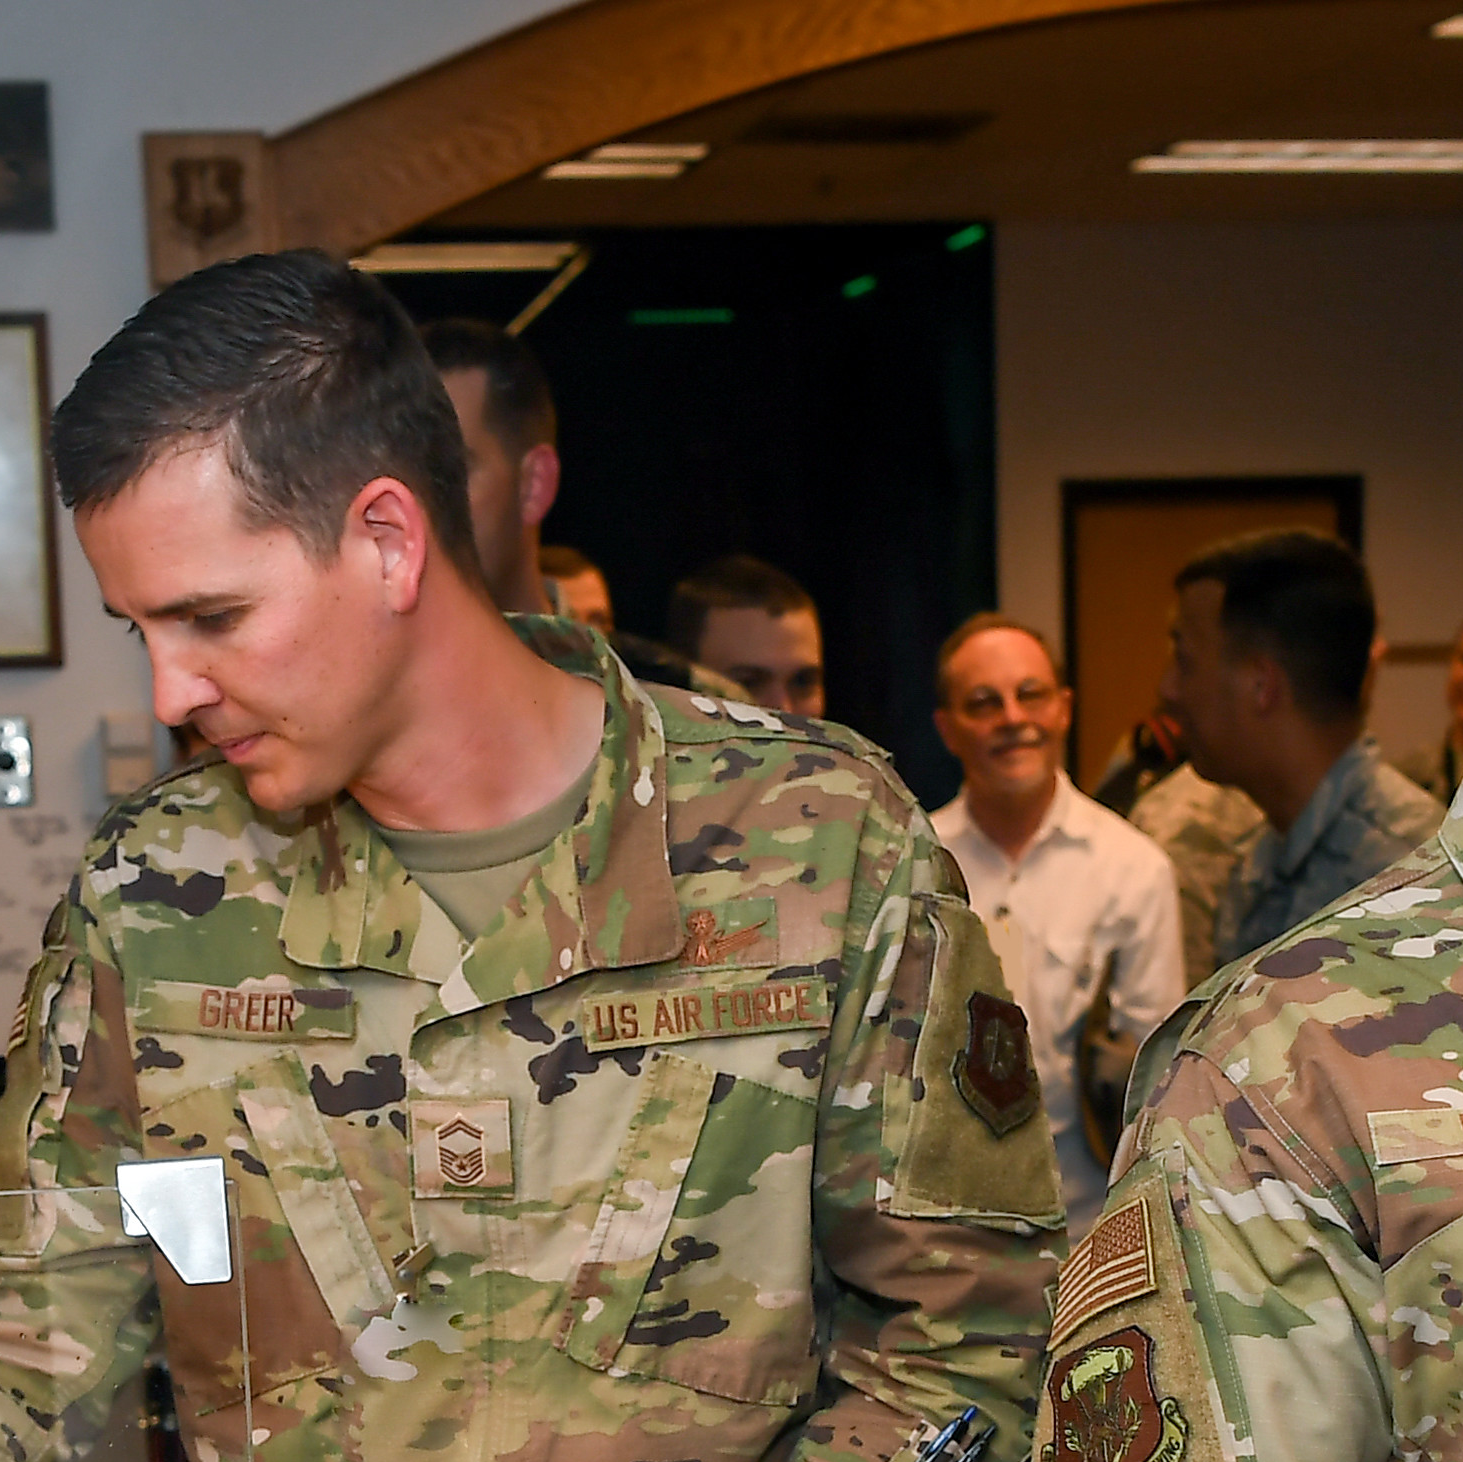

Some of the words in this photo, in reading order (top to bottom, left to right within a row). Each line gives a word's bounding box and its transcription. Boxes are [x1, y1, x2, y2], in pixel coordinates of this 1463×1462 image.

[200, 989, 294, 1032] GREER
[595, 1003, 643, 1041] U.S.
[654, 995, 705, 1037] AIR
[713, 984, 814, 1030] FORCE
